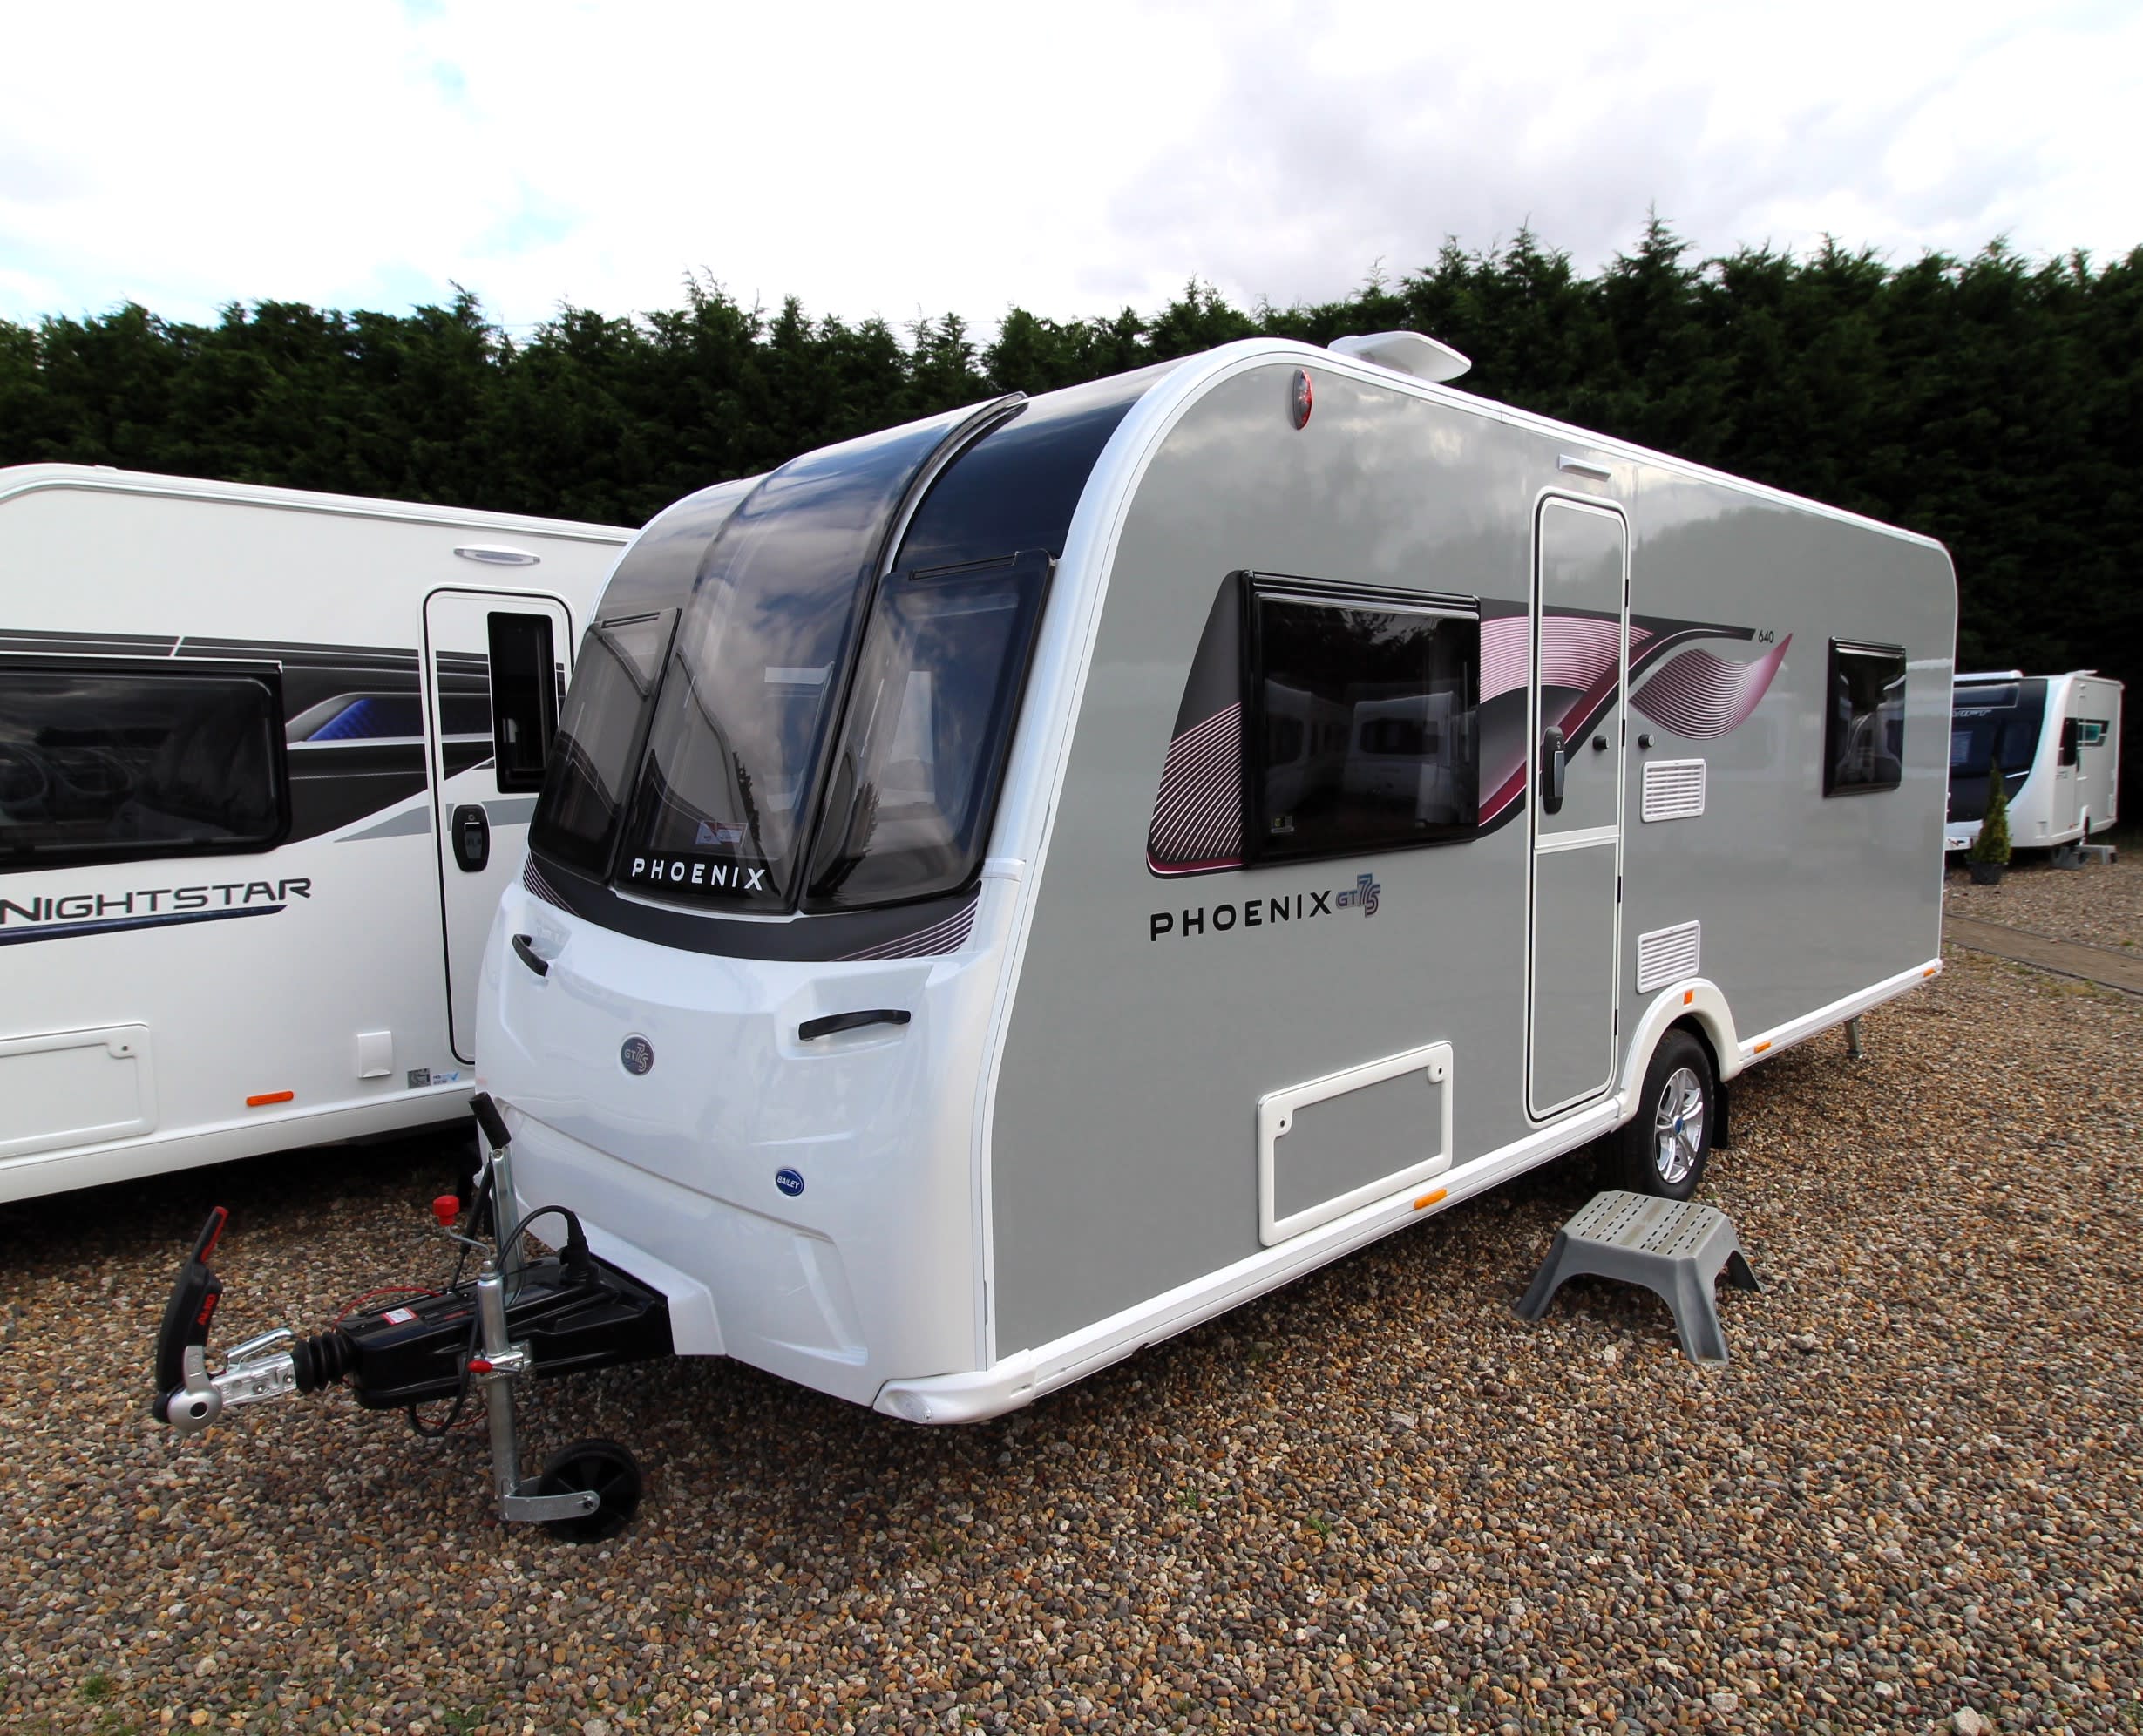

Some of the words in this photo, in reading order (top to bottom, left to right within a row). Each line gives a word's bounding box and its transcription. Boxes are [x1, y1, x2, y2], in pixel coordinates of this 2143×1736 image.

[1759, 630, 1774, 643] 640
[632, 858, 765, 891] PHOENIX
[0, 878, 311, 925] NIGHTSTAR
[1150, 881, 1332, 942] PHOENIX
[776, 1175, 801, 1189] BAILEY
